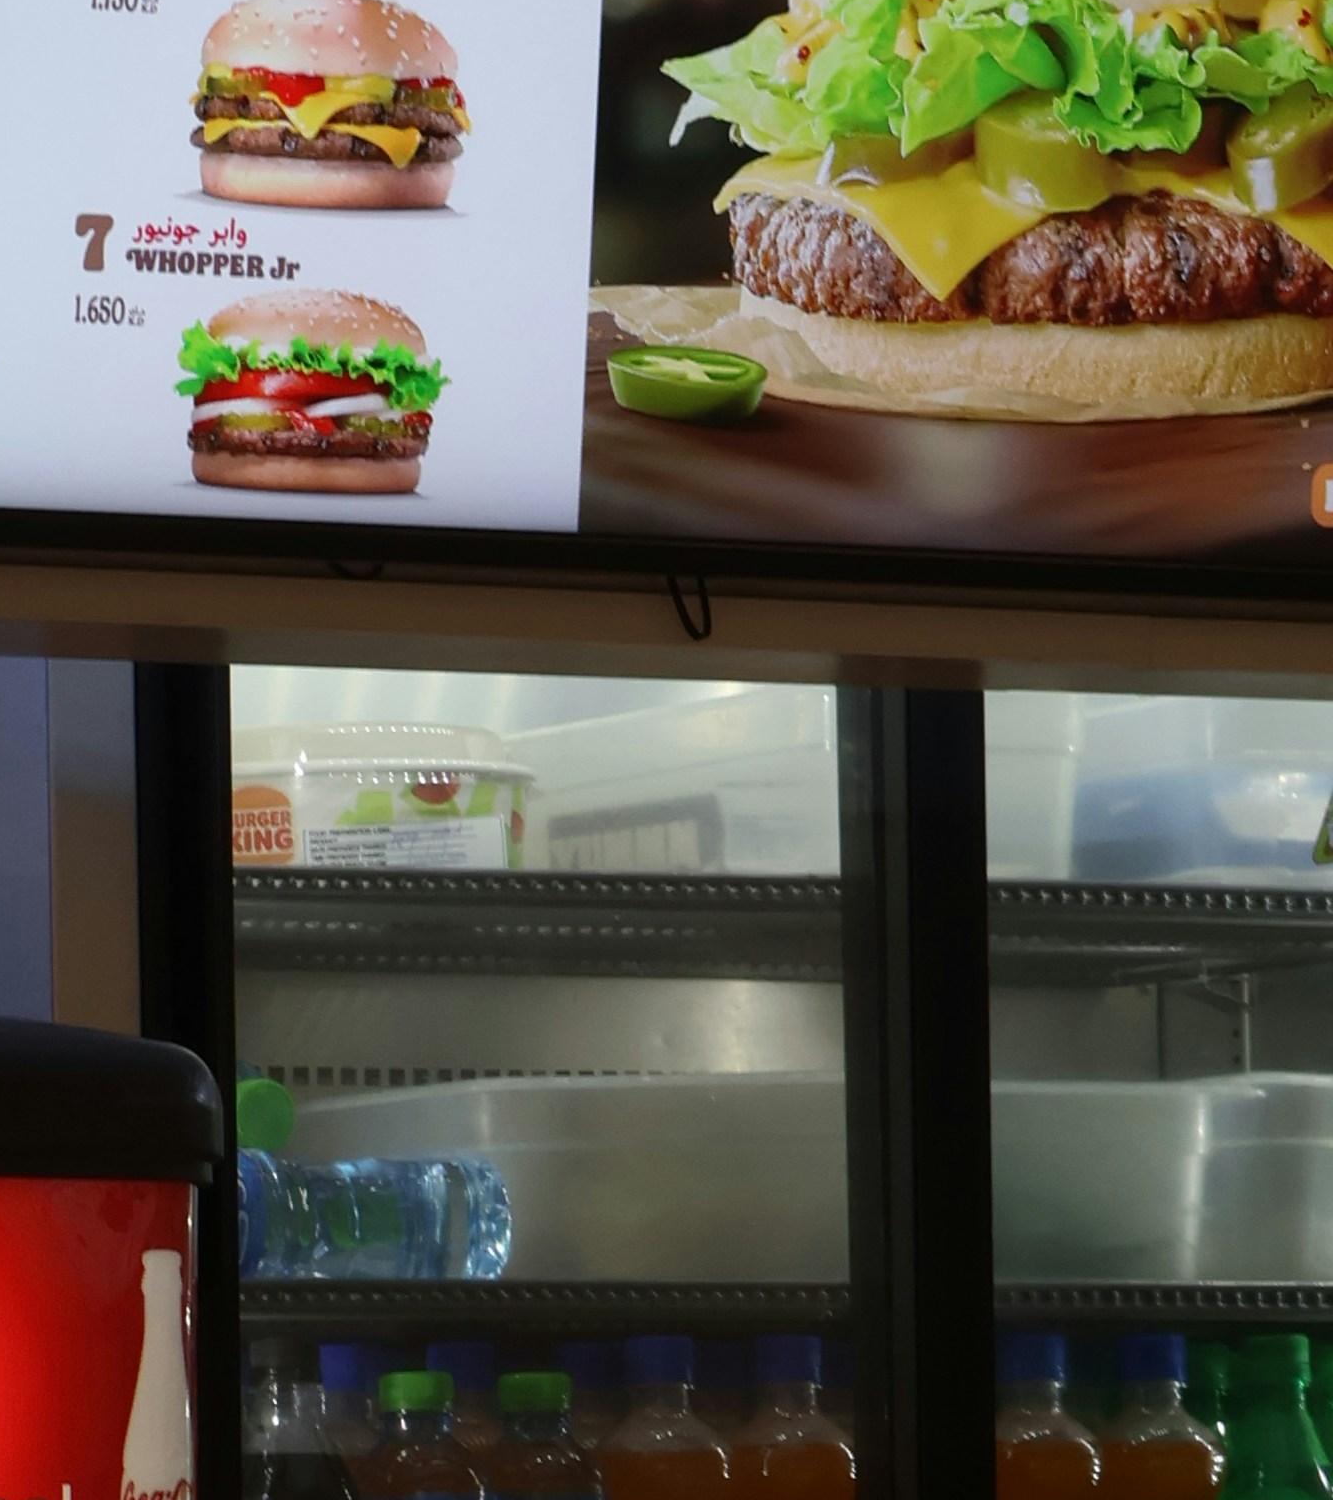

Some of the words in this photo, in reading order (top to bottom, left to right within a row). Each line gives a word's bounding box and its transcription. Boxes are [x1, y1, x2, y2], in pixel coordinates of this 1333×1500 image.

[75, 213, 115, 272] 7
[131, 215, 201, 247] جونيور
[208, 217, 249, 249] وابر
[125, 247, 265, 279] WHOPPER
[269, 255, 301, 282] Jr
[74, 295, 126, 326] 1.650
[233, 810, 292, 829] URGER
